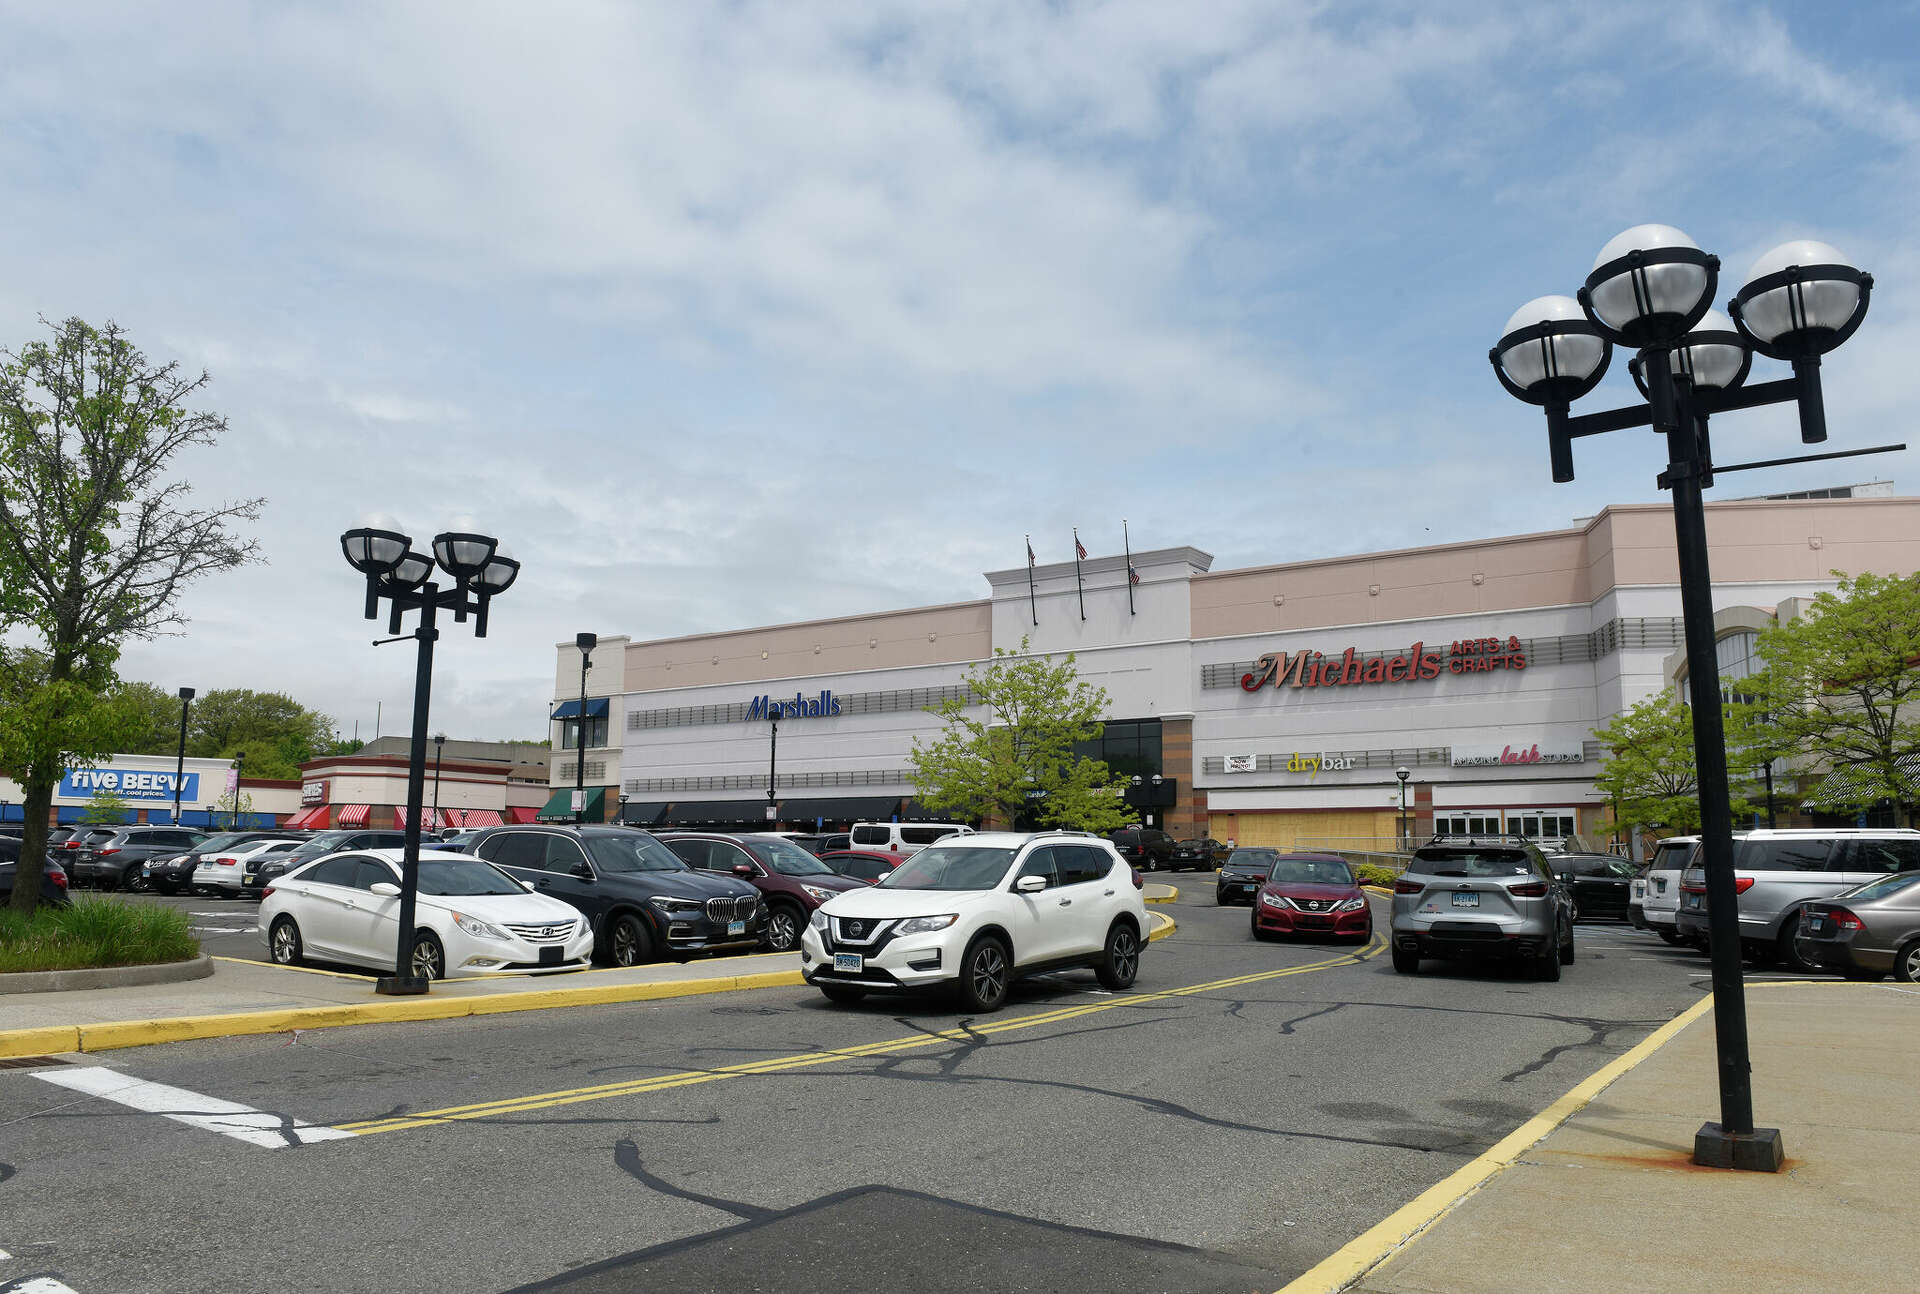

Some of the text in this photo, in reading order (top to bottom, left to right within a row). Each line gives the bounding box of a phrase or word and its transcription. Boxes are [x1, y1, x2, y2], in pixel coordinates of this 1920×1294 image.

[1450, 635, 1521, 656] ARTS &
[1241, 641, 1441, 692] Michaels
[1449, 653, 1527, 674] CRAFTS
[745, 690, 841, 720] Marshalls
[1500, 744, 1543, 764] lash
[1287, 752, 1355, 778] drybar
[71, 770, 118, 789] five
